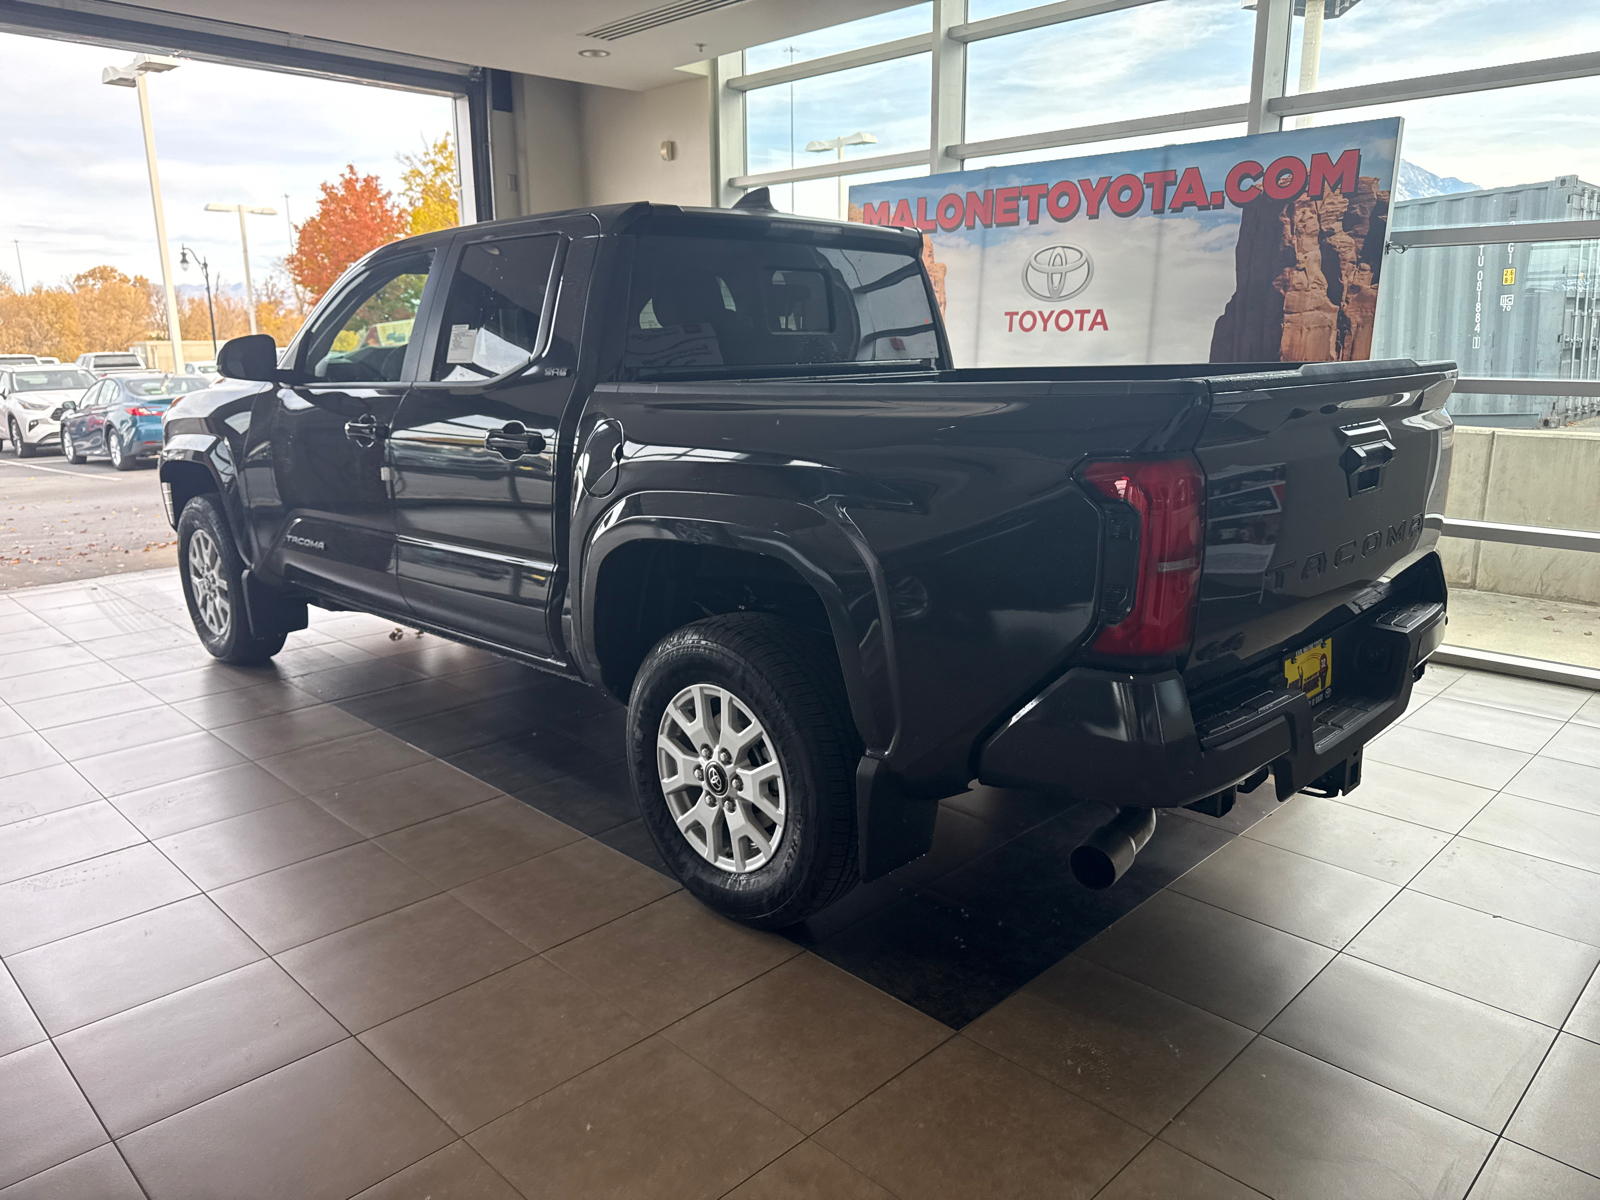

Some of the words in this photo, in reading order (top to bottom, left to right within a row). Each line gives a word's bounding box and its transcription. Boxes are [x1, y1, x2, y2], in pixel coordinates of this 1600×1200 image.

[862, 148, 1361, 233] MALONETOYOTA.COM
[1004, 309, 1109, 333] TOYOTA
[1474, 271, 1484, 333] 081884
[286, 534, 325, 550] TACOMA
[1264, 512, 1424, 590] TACOMA
